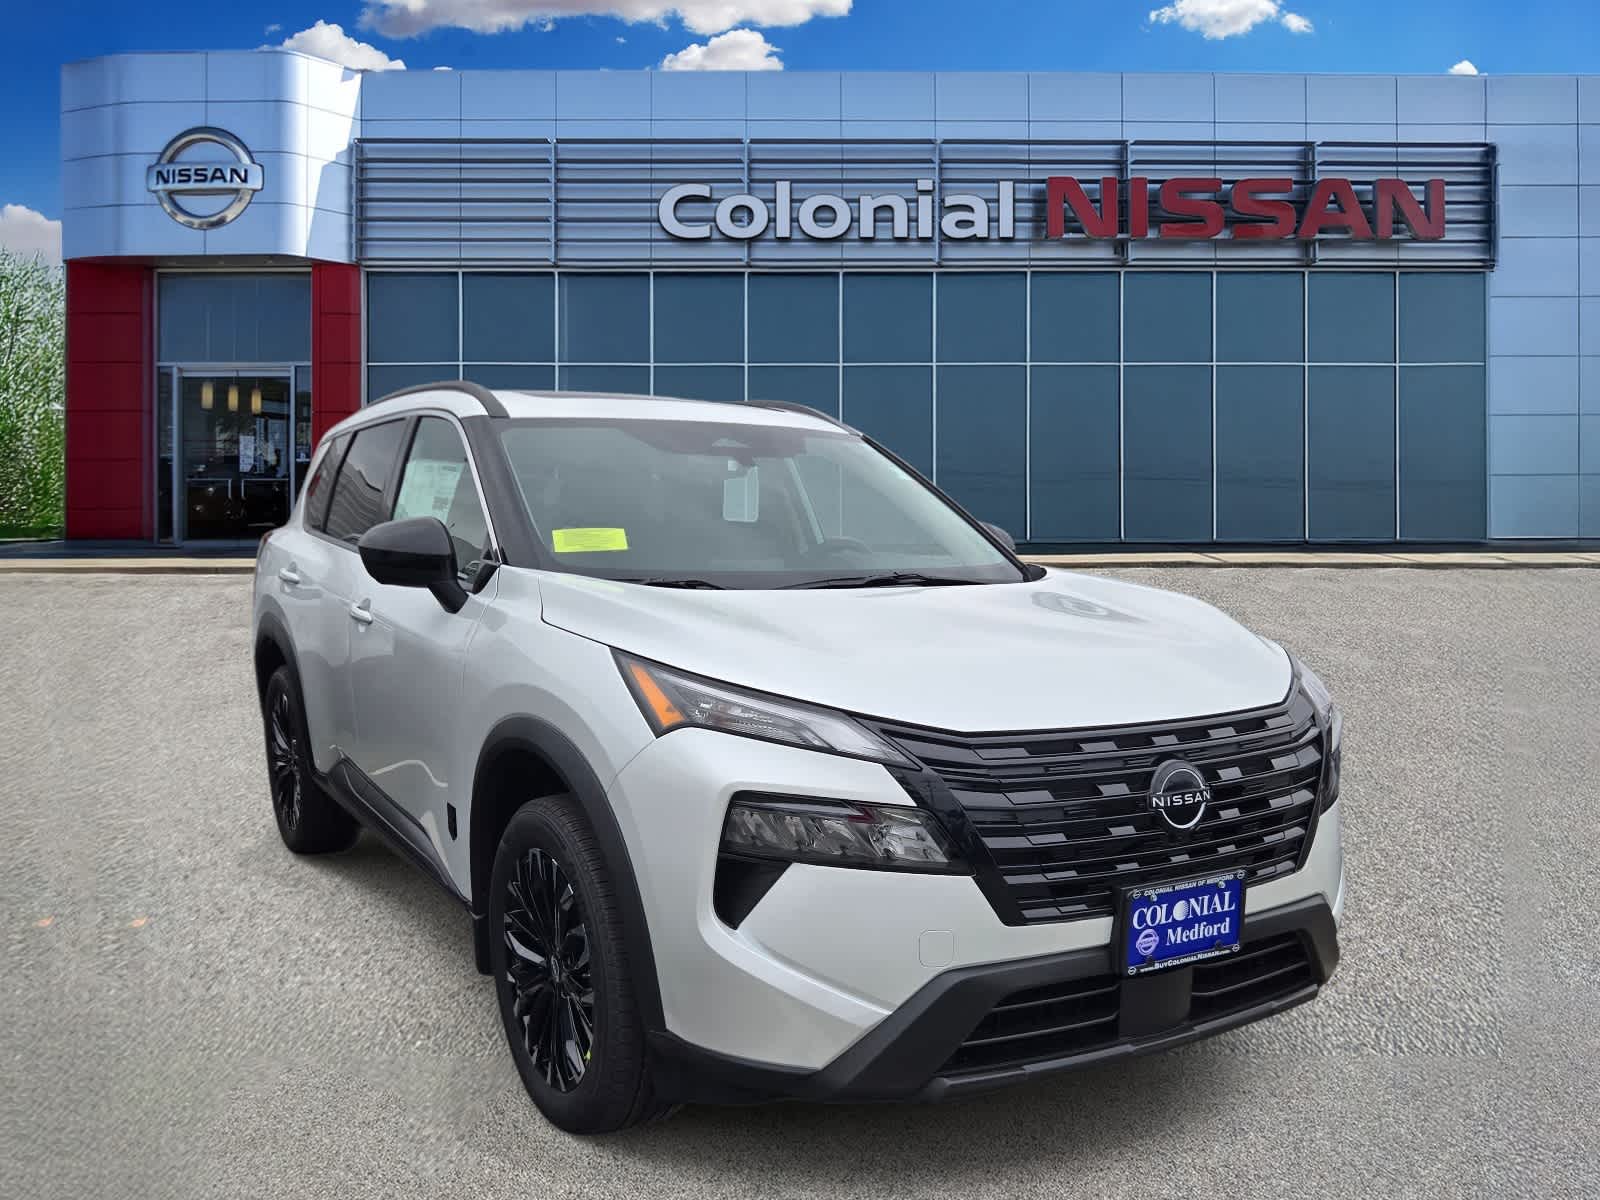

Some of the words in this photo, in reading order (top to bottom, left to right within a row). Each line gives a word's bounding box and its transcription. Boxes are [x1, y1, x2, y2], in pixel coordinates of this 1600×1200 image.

[156, 167, 248, 185] NISSAN
[658, 180, 1015, 240] Colonial
[1046, 176, 1446, 240] NISSAN
[1152, 790, 1211, 808] NISSAN
[1174, 882, 1197, 891] NISSAN
[1132, 891, 1236, 930] COLONIAL
[1165, 917, 1230, 946] Medford
